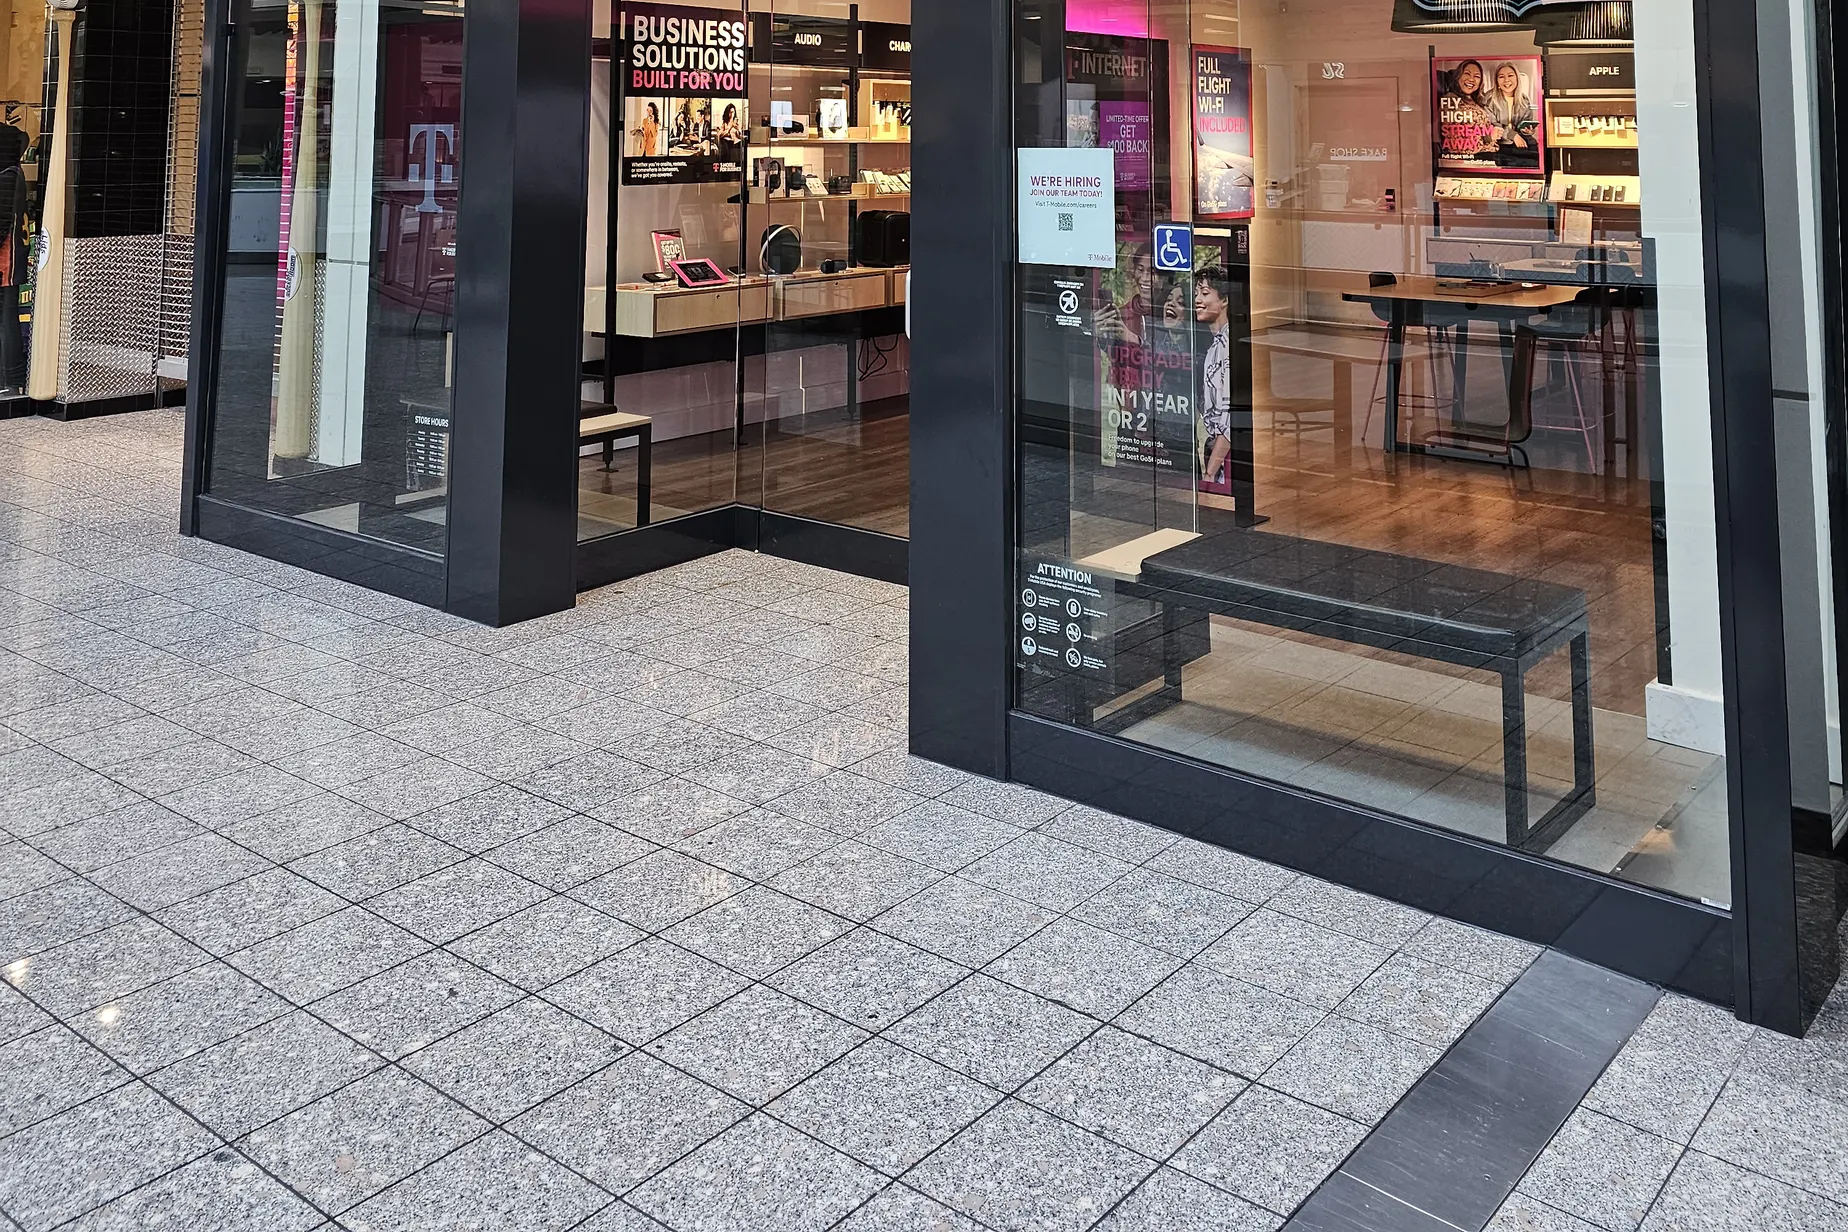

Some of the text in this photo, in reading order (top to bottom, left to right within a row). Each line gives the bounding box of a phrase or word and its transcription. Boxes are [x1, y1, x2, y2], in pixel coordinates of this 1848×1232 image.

[633, 15, 745, 48] BUSINESS
[794, 33, 822, 47] AUDIO
[889, 40, 911, 53] CHAR
[632, 45, 745, 71] SOLUTIONS
[1081, 52, 1147, 78] INTERNET
[1198, 57, 1221, 75] FULL
[1589, 67, 1620, 76] APPLE
[633, 71, 676, 89] BUILT
[680, 71, 711, 91] FOR
[712, 72, 744, 91] YOU
[1198, 77, 1232, 95] FLIGHT
[1198, 96, 1224, 114] WI-FI
[1440, 97, 1461, 109] FLY
[1106, 115, 1135, 123] LIMITED-TIME
[1440, 111, 1473, 123] HIGH
[1120, 124, 1136, 138] GET
[1200, 117, 1247, 133] INCLUDED
[1441, 124, 1494, 137] STREAM
[1442, 138, 1480, 149] AWAY
[1030, 176, 1101, 188] WE'RE HIRING
[1046, 189, 1059, 197] OUR
[1060, 189, 1078, 197] TEAM
[1080, 190, 1103, 198] TODAY!
[1107, 345, 1192, 370] UPGRADE
[1108, 387, 1189, 416] IN 1 YEAR
[414, 415, 449, 428] STORE HOURS
[1108, 409, 1147, 432] OR 2
[1121, 445, 1139, 454] phone
[1126, 452, 1139, 461] best
[1037, 562, 1092, 585] ATTENTION
